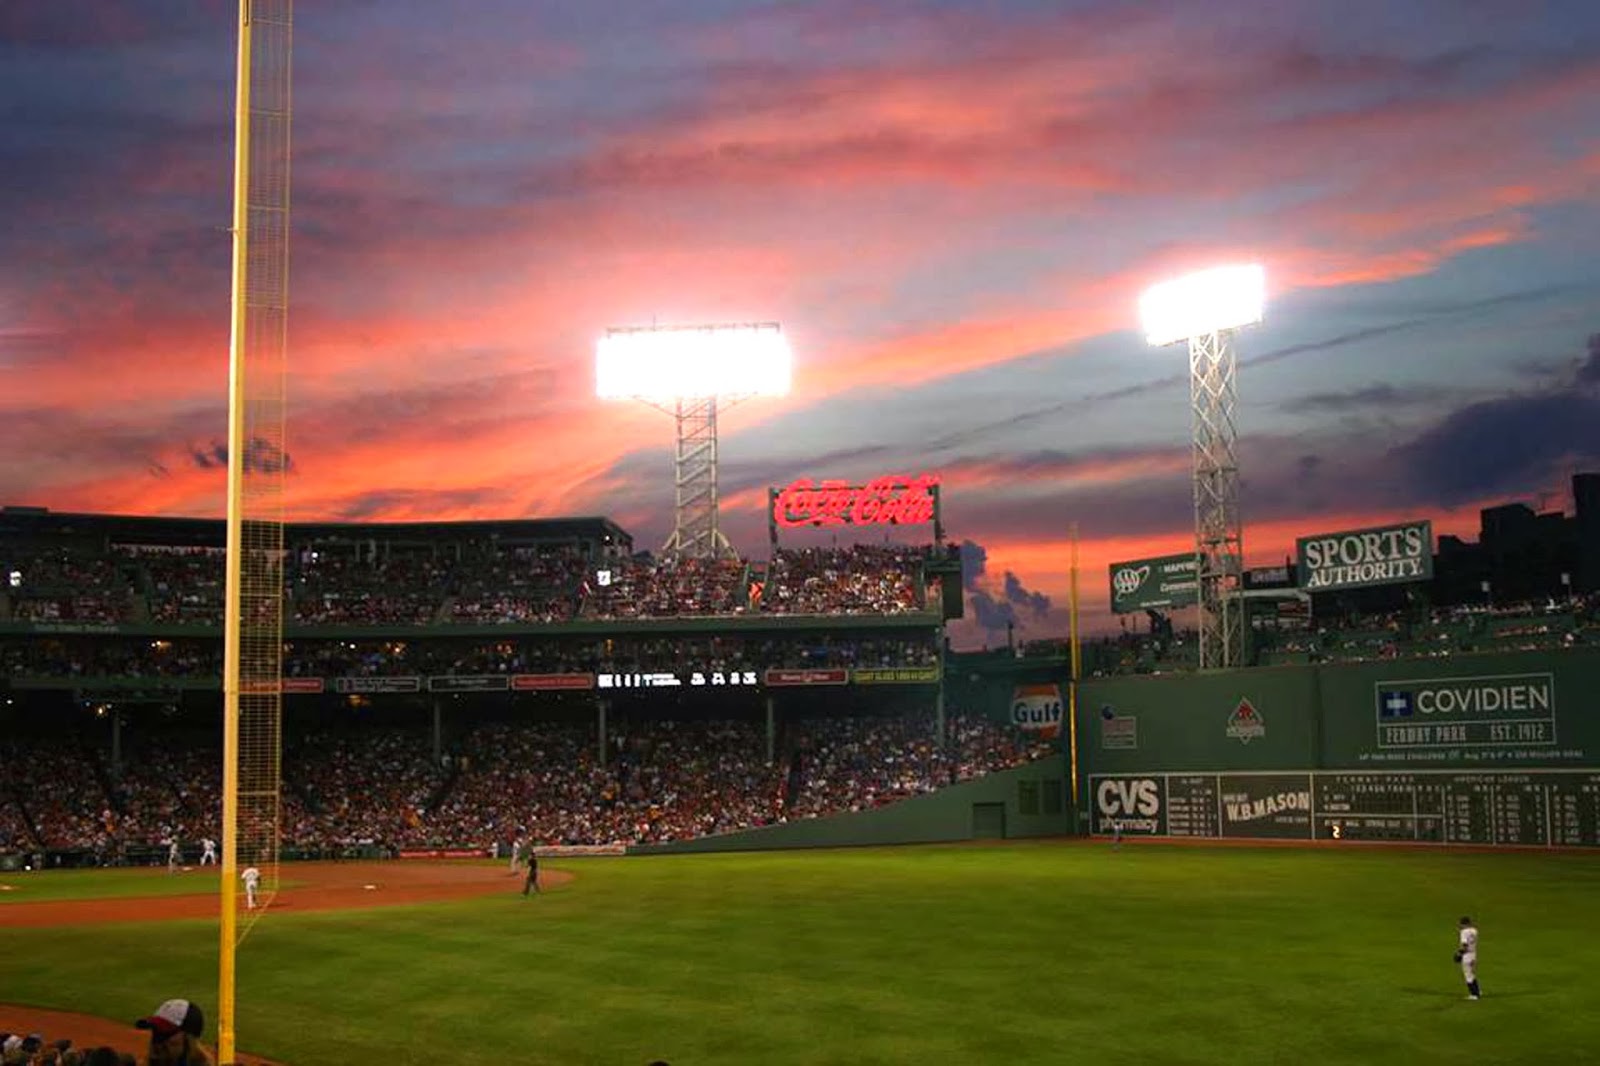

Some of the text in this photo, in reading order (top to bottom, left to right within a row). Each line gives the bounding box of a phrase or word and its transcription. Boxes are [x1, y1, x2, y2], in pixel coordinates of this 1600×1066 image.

[774, 472, 940, 528] Coca-Cola
[1306, 527, 1421, 569] SPORTS
[1014, 702, 1060, 724] Gulf
[1417, 685, 1549, 713] COVIDIEN
[1097, 779, 1159, 816] CVS
